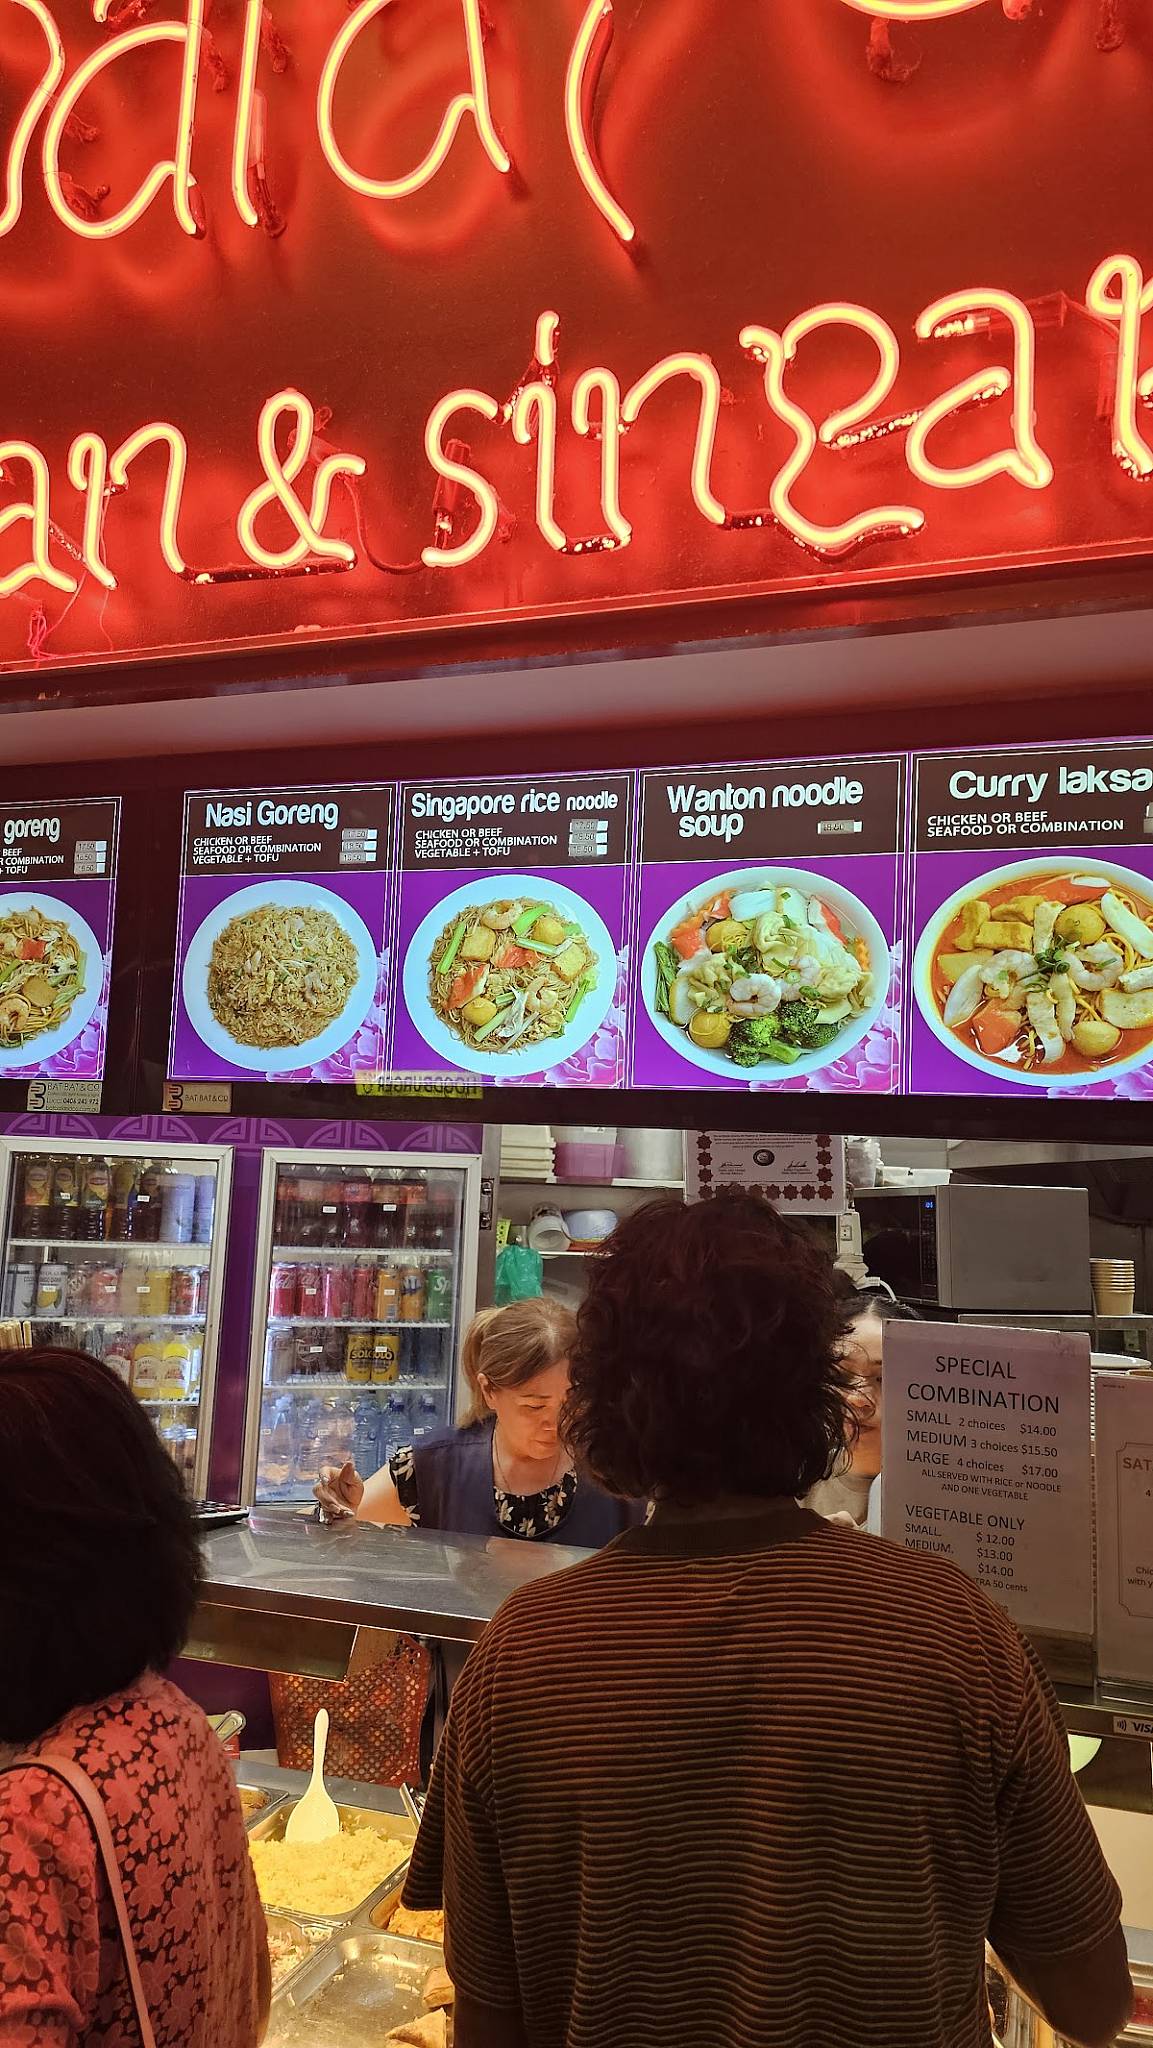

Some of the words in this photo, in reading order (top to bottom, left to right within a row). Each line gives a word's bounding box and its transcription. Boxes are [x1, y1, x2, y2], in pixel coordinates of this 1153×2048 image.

[236, 389, 366, 569] &
[949, 770, 1049, 802] Curry
[1059, 764, 1153, 795] laksa
[667, 782, 766, 813] Wanton
[772, 776, 864, 808] noodle
[411, 792, 516, 823] Singapore
[520, 788, 560, 813] rice
[566, 791, 619, 811] noodle
[205, 801, 252, 828] Nasi
[257, 800, 339, 830] Goreng
[927, 814, 987, 827] CHICKEN
[990, 812, 1011, 824] OR
[1015, 811, 1048, 823] BEEF
[4, 817, 61, 845] goreng
[415, 829, 459, 840] CHICKEN
[461, 828, 477, 838] OR
[478, 827, 503, 837] BEEF
[679, 812, 744, 843] soup
[927, 825, 992, 837] SEAFOOD
[996, 823, 1017, 835] OR
[1020, 819, 1125, 834] COMBINATION
[193, 837, 233, 847] CHICKEN
[234, 836, 249, 846] OR
[250, 835, 273, 845] BEEF
[193, 846, 237, 856] SEAFOOD
[238, 845, 251, 855] OR
[253, 842, 322, 854] COMBINATION
[414, 839, 462, 849] SEAFOOD
[464, 837, 480, 847] OR
[482, 835, 558, 847] COMBINATION
[2, 847, 23, 857] BEEF
[5, 855, 65, 865] COMBINATION
[192, 855, 243, 865] VEGETABLE
[244, 855, 252, 863] +
[253, 853, 279, 863] TOFU
[414, 848, 471, 859] VEGETABLE
[472, 848, 480, 856] +
[482, 846, 511, 857] TOFU
[5, 866, 28, 874] TOFU
[935, 1355, 1017, 1380] SPECIAL
[907, 1383, 1059, 1414] COMBINATION
[907, 1410, 951, 1426] SMALL
[958, 1417, 966, 1427] 2
[967, 1418, 1006, 1432] choices
[1019, 1423, 1057, 1437] $14.00
[907, 1430, 967, 1448] MEDIUM
[971, 1440, 977, 1449] 3
[980, 1440, 1019, 1453] choices
[1021, 1444, 1058, 1458] $15.50
[906, 1450, 950, 1466] LARGE
[957, 1458, 964, 1467] 4
[966, 1458, 1005, 1472] choices
[1021, 1464, 1059, 1479] $17.00
[921, 1469, 937, 1478] ALL
[937, 1470, 969, 1482] SERVED
[970, 1474, 993, 1484] WITH
[994, 1477, 1013, 1487] RICE
[1015, 1480, 1024, 1488] or
[1026, 1481, 1062, 1493] NOODLE
[941, 1483, 960, 1493] AND
[961, 1485, 980, 1495] ONE
[981, 1487, 1029, 1501] VEGETABLE
[905, 1503, 983, 1526] VEGETABLE
[987, 1514, 1026, 1531] ONLY
[986, 1533, 1015, 1546] 12.00
[905, 1537, 954, 1554] MEDIUM.
[976, 1546, 1013, 1562] $13.00
[978, 1561, 1014, 1577] $14.00
[993, 1580, 1003, 1589] 50
[1005, 1583, 1028, 1592] cents
[1132, 1721, 1153, 1734] VIS
